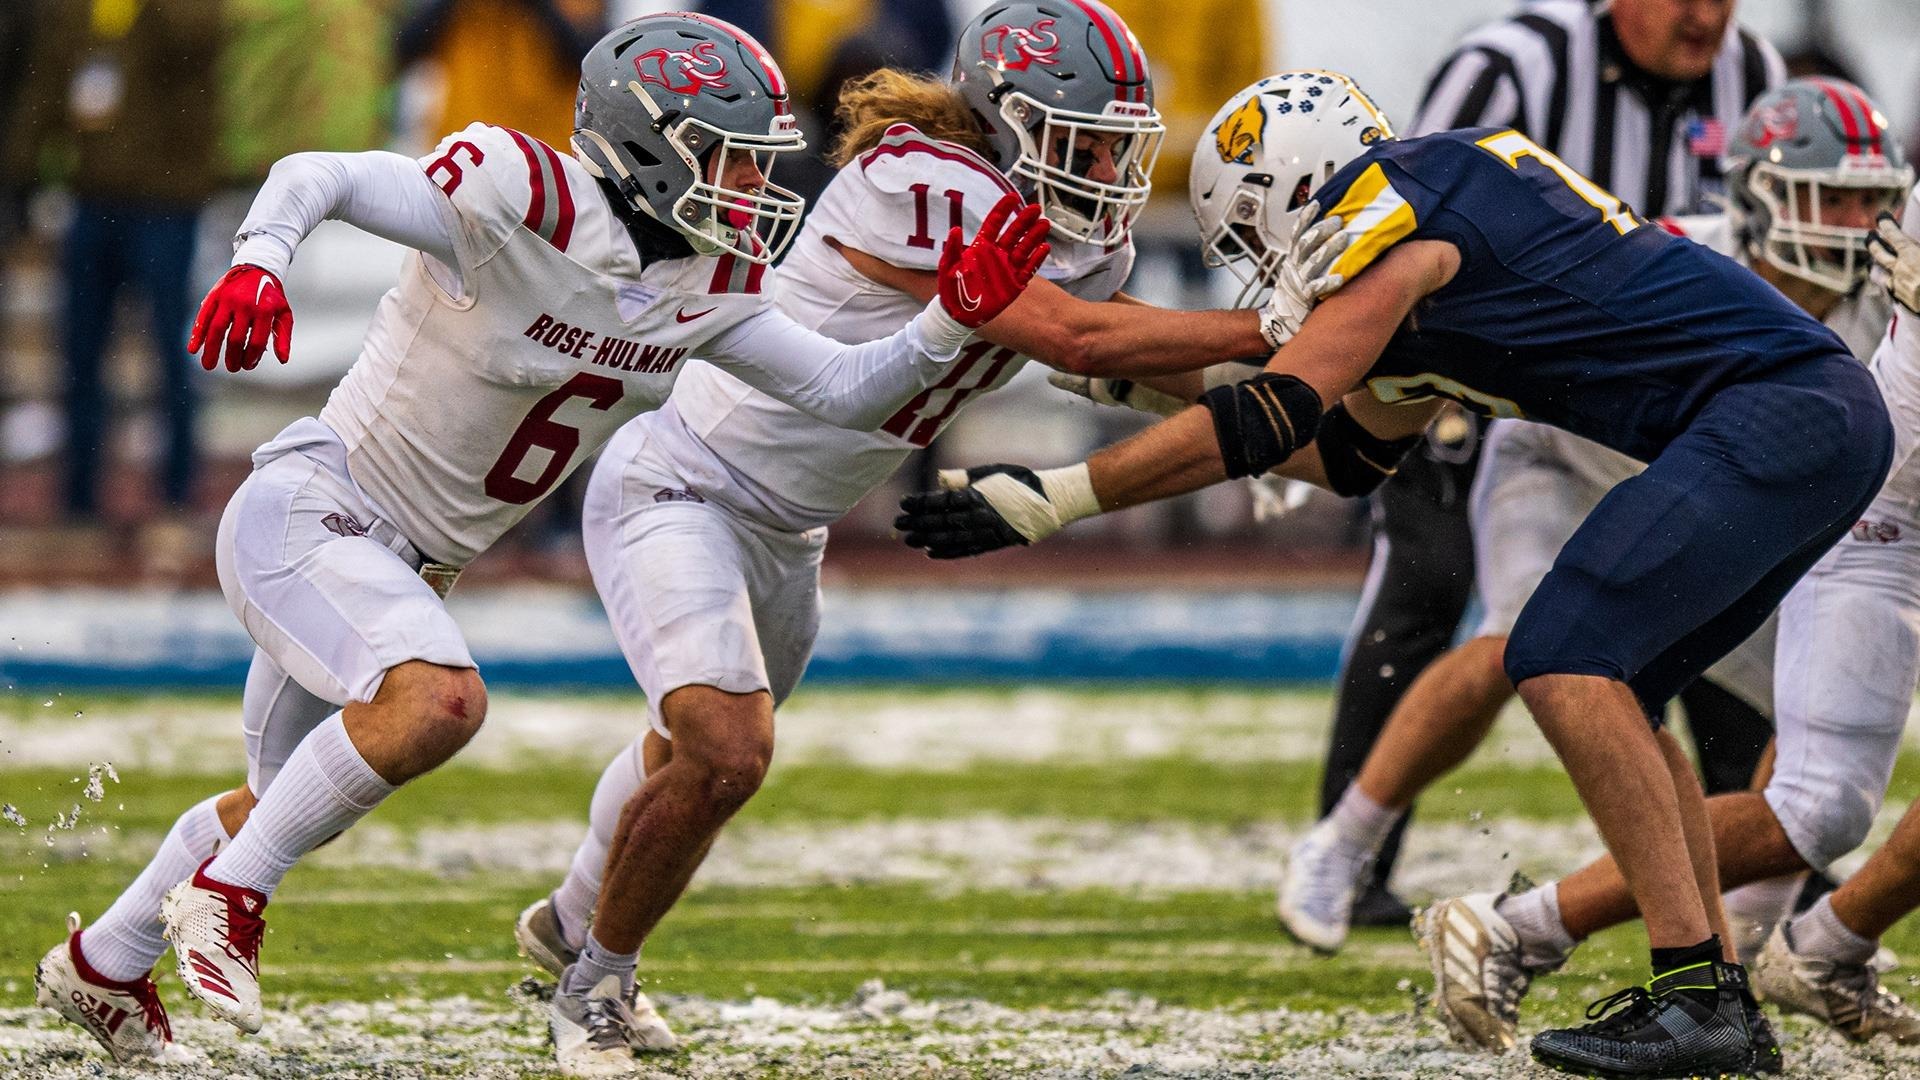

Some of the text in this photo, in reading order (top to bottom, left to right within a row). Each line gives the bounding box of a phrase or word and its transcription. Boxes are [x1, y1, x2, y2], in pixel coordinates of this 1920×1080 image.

[426, 141, 484, 198] 6
[906, 183, 970, 252] 11
[523, 313, 688, 373] ROSE-HULMAN
[484, 371, 624, 505] 6
